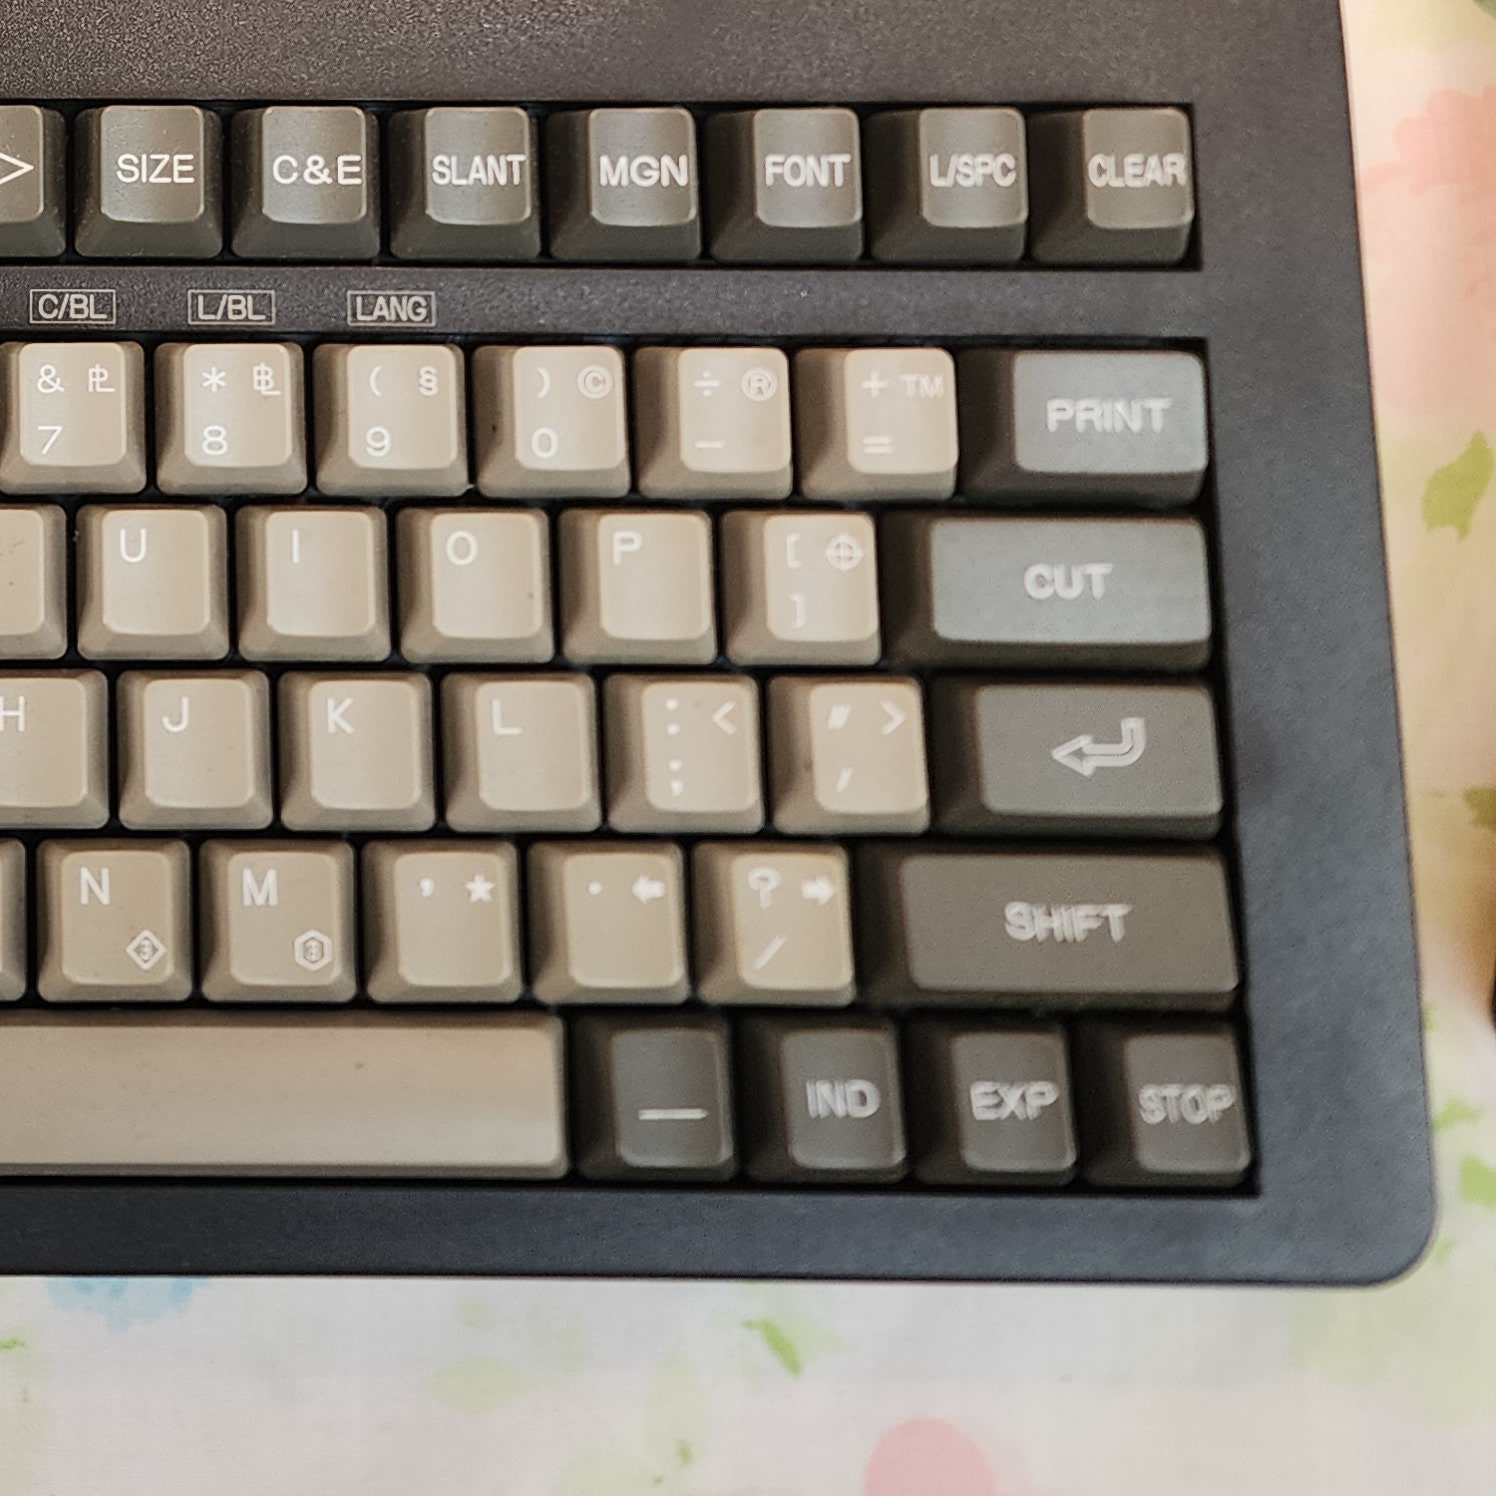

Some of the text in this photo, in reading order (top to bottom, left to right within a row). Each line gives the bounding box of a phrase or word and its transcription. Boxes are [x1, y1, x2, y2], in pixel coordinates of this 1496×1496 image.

[115, 155, 194, 185] SIZE
[431, 155, 527, 186] SLANT
[599, 155, 688, 187] MGN
[764, 155, 851, 186] FONT
[928, 155, 1016, 187] L/SPC
[1088, 154, 1187, 188] CLEAR
[38, 294, 107, 320] C/BL
[197, 294, 266, 320] L/BL
[355, 296, 427, 321] LANG
[37, 365, 65, 393] &
[1046, 398, 1172, 432] PRINT
[37, 425, 63, 455] 7
[202, 426, 228, 455] 8
[366, 427, 391, 456] 9
[119, 529, 146, 562] U
[291, 529, 300, 563] I
[446, 531, 478, 565] O
[613, 531, 643, 566] P
[1024, 563, 1113, 601] CUT
[162, 697, 189, 733] J
[327, 698, 355, 734] K
[494, 699, 522, 735] L
[81, 868, 109, 904] N
[242, 869, 277, 905] M
[1003, 902, 1133, 943] SHIFT
[805, 1079, 880, 1119] IND
[969, 1081, 1059, 1121] EXP
[1139, 1084, 1237, 1125] STOP
